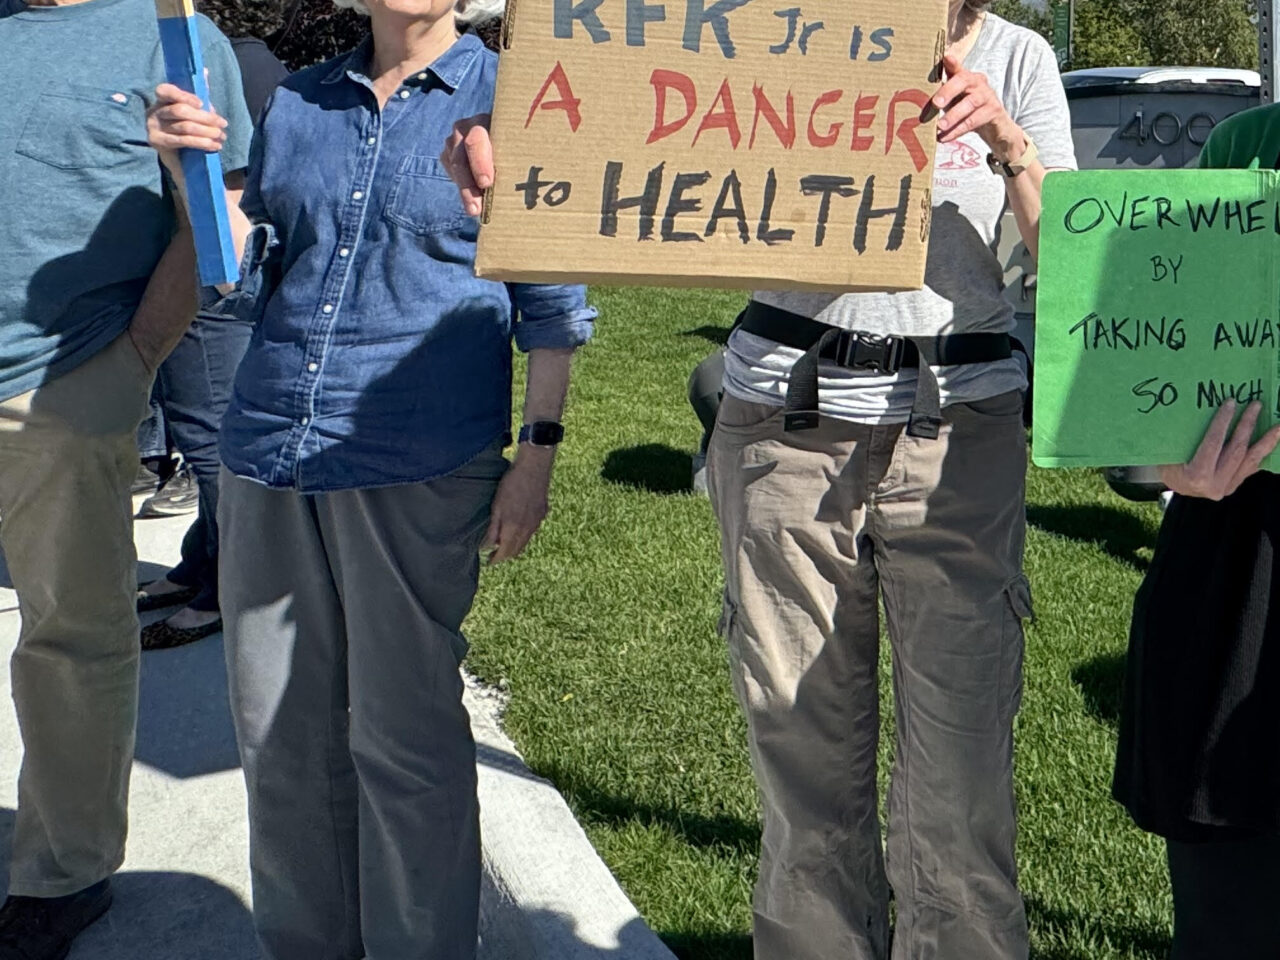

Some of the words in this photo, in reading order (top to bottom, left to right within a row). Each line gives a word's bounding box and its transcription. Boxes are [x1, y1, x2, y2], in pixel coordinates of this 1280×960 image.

[768, 6, 826, 56] Jr
[524, 60, 582, 133] A
[645, 68, 933, 173] DANGER
[515, 165, 571, 210] to
[599, 160, 913, 256] HEALTH
[1150, 254, 1183, 284] BY
[1069, 311, 1186, 351] TAKING
[1132, 377, 1178, 413] SO
[1197, 379, 1263, 409] MUCH
